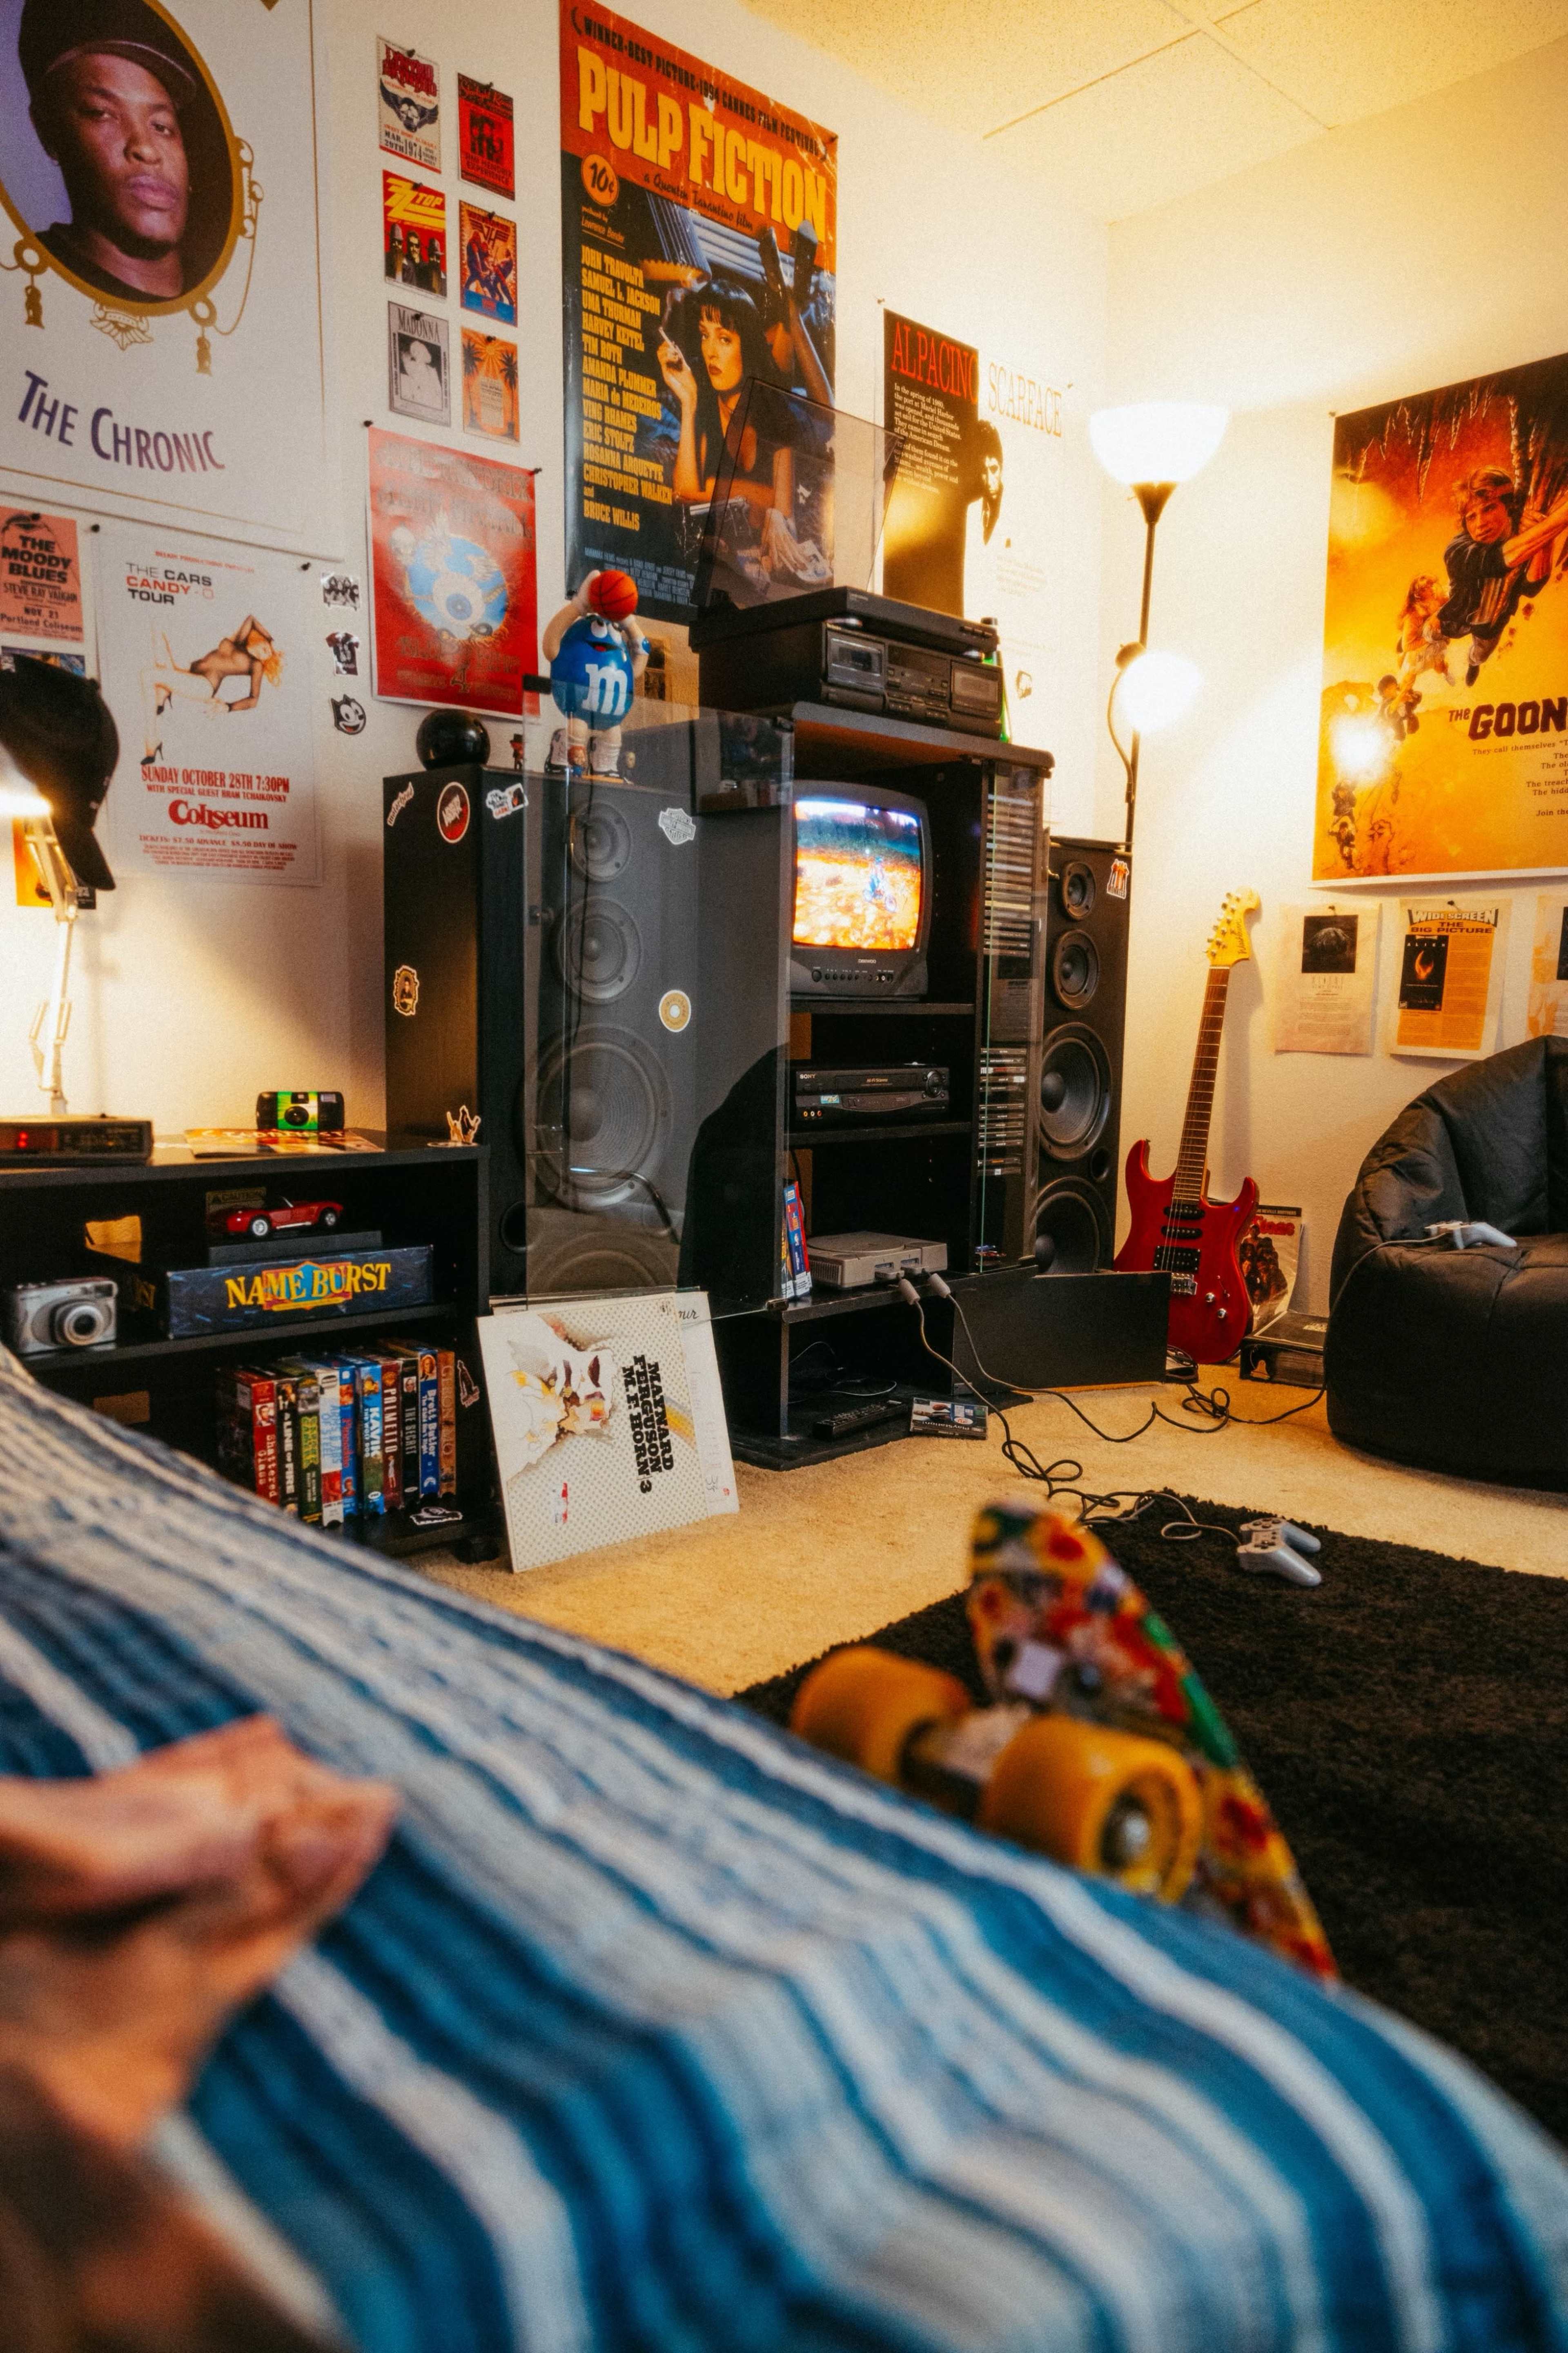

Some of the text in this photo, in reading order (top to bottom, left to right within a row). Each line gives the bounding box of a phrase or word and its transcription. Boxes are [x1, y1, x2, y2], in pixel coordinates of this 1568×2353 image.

[722, 91, 756, 124] CANNES
[758, 109, 778, 134] FILM
[780, 122, 819, 157] FESTIVAL
[577, 45, 827, 243] PULP FICTION
[414, 192, 444, 207] TOP
[654, 173, 688, 200] Quentin
[693, 190, 734, 221] Tarantino
[737, 207, 753, 231] film
[581, 245, 644, 289] JOHN TRAVOLTA
[581, 267, 660, 316] SAMUEL L. JACKSON
[582, 289, 641, 330] UMA THURMAN
[397, 307, 441, 343] MADONNA
[582, 311, 645, 352] HARVEY KEITEL
[582, 332, 623, 365] TIM ROTH
[583, 355, 657, 399] AMANDA PLUMMER
[895, 382, 900, 391] In
[901, 386, 909, 395] the
[910, 391, 926, 403] spring
[932, 398, 945, 409] 1980,
[583, 376, 662, 421] MARIA de MEDEIROS
[583, 398, 637, 433] VING RHAMES
[894, 392, 903, 401] the
[904, 397, 914, 406] port
[920, 401, 937, 414] Mariel
[938, 408, 955, 421] Harbor
[894, 402, 960, 431] was opened, and thousands
[988, 361, 1062, 439] SCARFACE
[18, 370, 226, 473] THE CHRONIC
[583, 419, 635, 454] ERIC STOLTZ
[894, 416, 943, 442] They came in search
[900, 428, 909, 437] the
[909, 431, 933, 446] American
[933, 439, 951, 453] Dream.
[902, 413, 912, 422] sail
[920, 419, 929, 428] the
[929, 421, 945, 433] United
[945, 428, 962, 440] States.
[583, 441, 664, 483] ROSANNA ARQUETTE
[583, 462, 673, 506] CHRISTOPHER WALKEN
[583, 498, 641, 532] BRUCE WILLIS
[1, 545, 72, 569] MOODY
[19, 535, 56, 553] THE
[9, 562, 67, 584] BLUES
[125, 562, 212, 587] THE CARS
[127, 588, 175, 605] TOUR
[0, 612, 83, 633] Portland Coliseum
[581, 663, 628, 716] m
[1468, 696, 1568, 741] GOON
[1511, 741, 1556, 752] themselves
[140, 764, 290, 793] SUNDAY OCTOBER 28TH 7:30PM
[146, 784, 165, 793] WITH
[168, 785, 196, 796] SPECIAL
[198, 788, 219, 798] GUEST
[168, 798, 269, 830] Coliseum
[225, 1262, 391, 1308] NAME BURST
[384, 1388, 398, 1454] PALMETTO
[427, 1389, 438, 1457] Brett Butler
[441, 1366, 452, 1456] GERONMO
[633, 1354, 663, 1474] FERGUSON
[647, 1361, 675, 1472] MAYNARD
[283, 1421, 294, 1452] LINE
[370, 1406, 381, 1458] KAVIK
[405, 1408, 417, 1455] THE SECRET
[257, 1450, 266, 1485] Glass
[266, 1434, 278, 1498] Shattered
[629, 1411, 651, 1477] HORN
[640, 1479, 653, 1494] 3
[285, 1463, 295, 1494] FIRE
